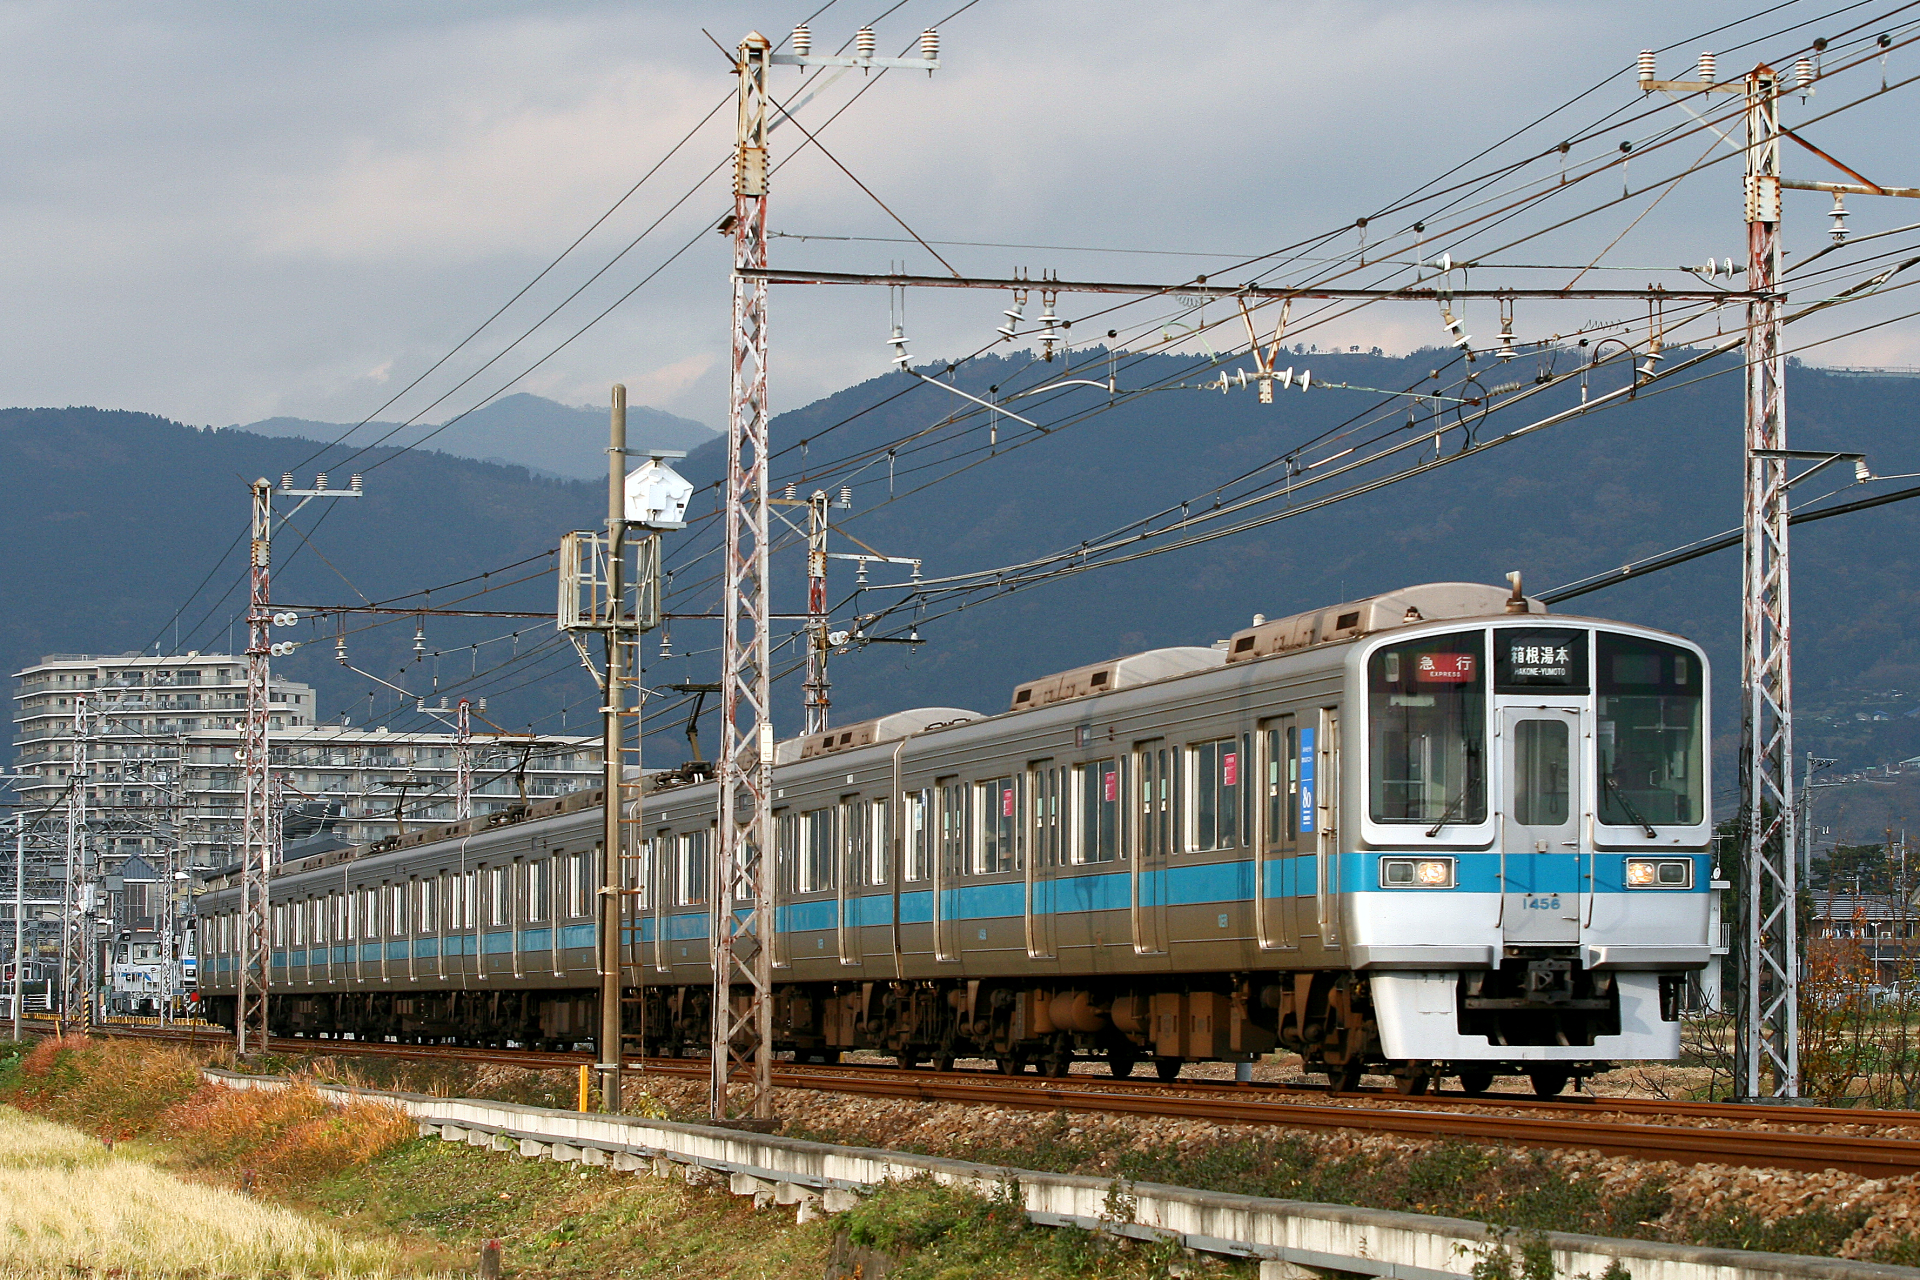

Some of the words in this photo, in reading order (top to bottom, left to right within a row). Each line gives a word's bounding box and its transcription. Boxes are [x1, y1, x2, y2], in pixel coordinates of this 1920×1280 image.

[1510, 645, 1570, 665] 箱根湯本
[1419, 655, 1472, 671] 急行
[1514, 667, 1566, 676] HAKONE-YUMOTO
[1522, 897, 1561, 910] 1456
